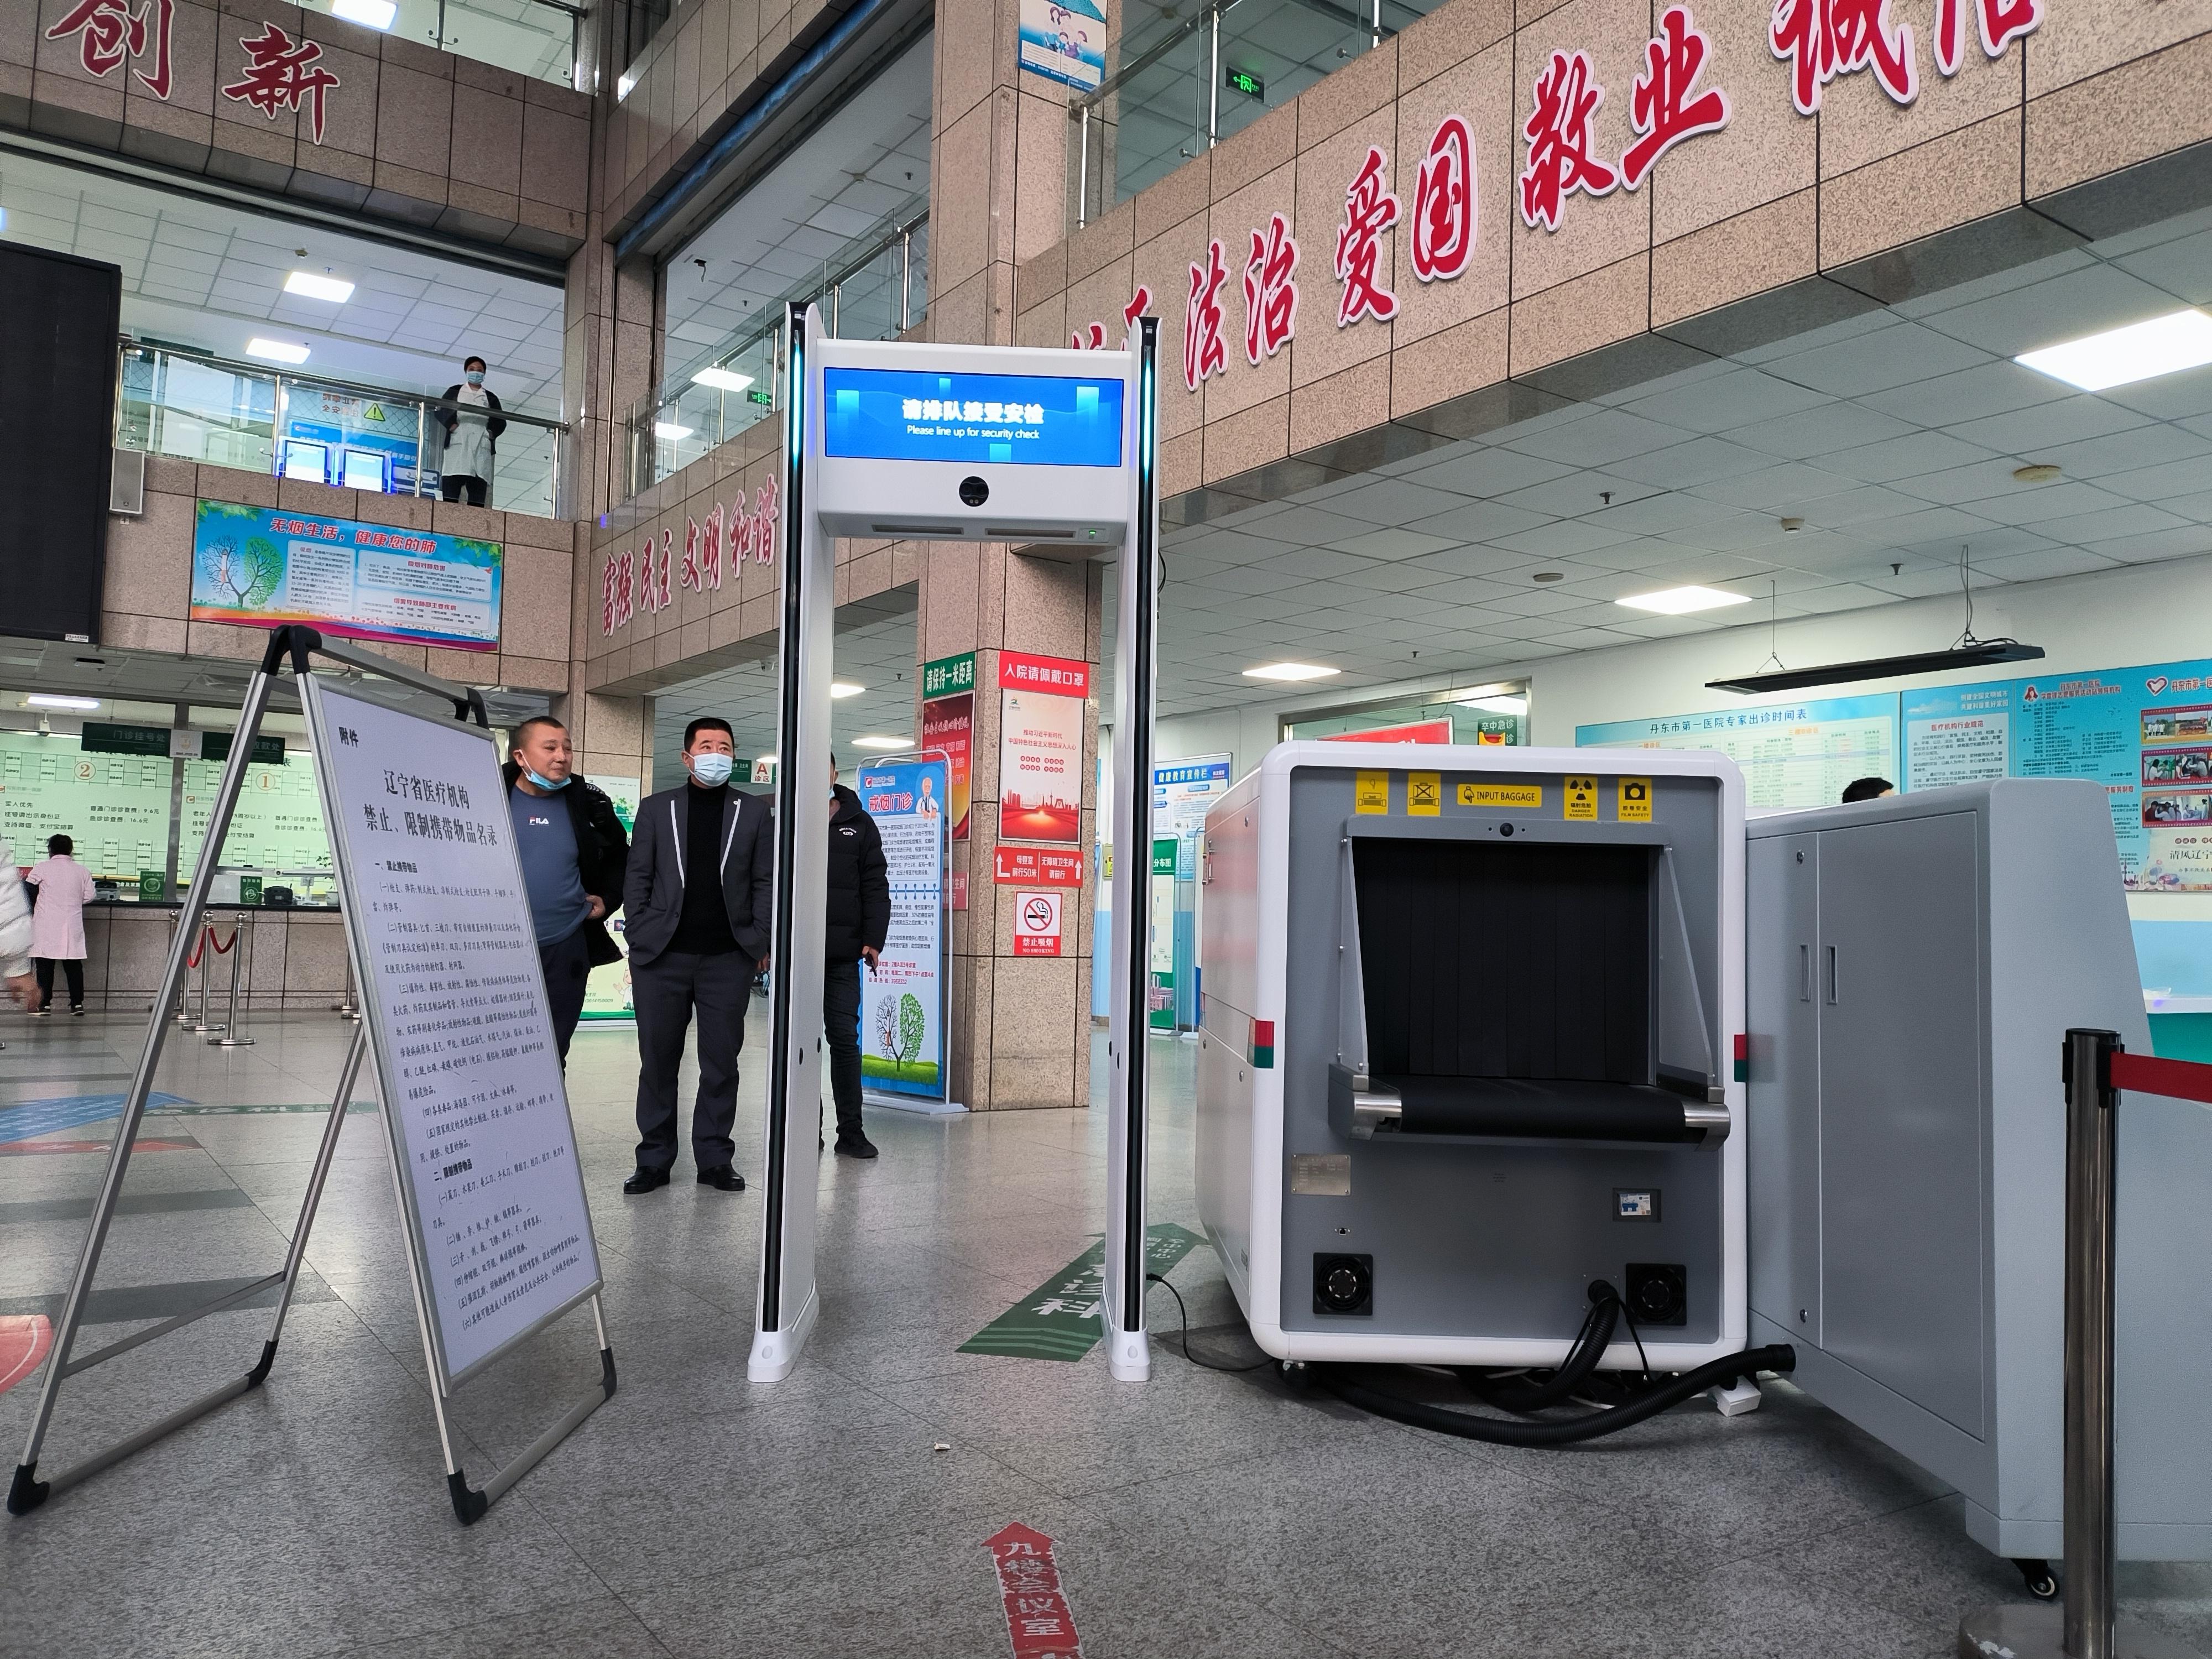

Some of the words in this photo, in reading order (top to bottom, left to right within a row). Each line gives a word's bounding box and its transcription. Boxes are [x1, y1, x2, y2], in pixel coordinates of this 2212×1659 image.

[45, 0, 340, 145] 创新
[1183, 211, 1300, 392] 法治
[1334, 114, 1479, 329] 爱国
[1520, 5, 1733, 232] 敬业
[902, 399, 1044, 424] 请排队接受安检
[907, 425, 934, 435] Please
[936, 426, 951, 436] line
[953, 429, 965, 438] up
[967, 427, 979, 437] for
[982, 429, 1013, 440] security
[1015, 430, 1039, 439] check
[640, 528, 672, 614] 民主
[681, 502, 724, 593] 文明
[729, 473, 779, 578] 和谐
[927, 660, 973, 692] 请保持一米距离
[1481, 719, 1514, 731] 卒中急诊
[1650, 708, 1807, 734] 丹东市第一医院专家出诊时间表
[1931, 720, 1984, 731] 医疗机构行业规范
[113, 730, 165, 743] 门诊挂号处
[338, 726, 359, 748] 附件
[80, 764, 90, 778] 2
[757, 763, 768, 774] A
[1159, 768, 1207, 783] 健康教育宣传栏
[262, 775, 269, 788] 1
[383, 769, 469, 810] 辽宁省医疗机构
[1477, 791, 1499, 800] INPUT
[1501, 792, 1535, 801] BAGGAGE
[869, 793, 912, 812] 戒烟门诊
[363, 803, 497, 846] 禁止、限制携带物品名录
[1016, 855, 1034, 865] 母婴室
[1041, 857, 1074, 868] 无障碍卫生间
[1154, 858, 1171, 867] 分布图
[1012, 868, 1037, 878] 前行50米
[1049, 870, 1066, 880] 请前行
[1022, 937, 1053, 947] 禁止吸烟
[1003, 1542, 1065, 1636] 九楼会议室
